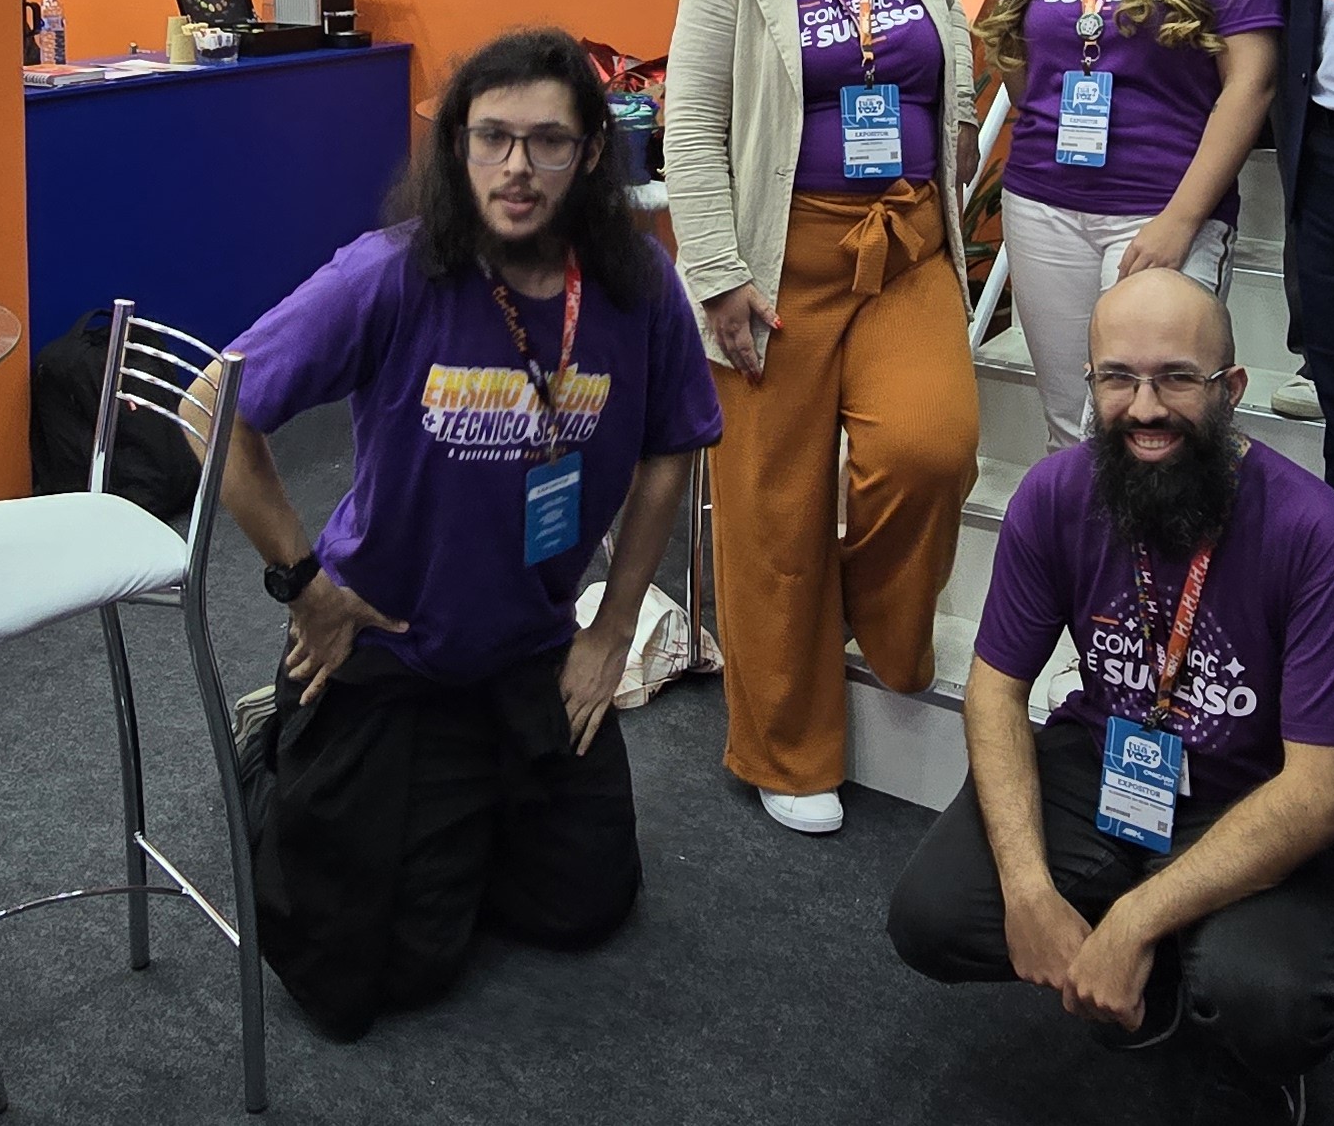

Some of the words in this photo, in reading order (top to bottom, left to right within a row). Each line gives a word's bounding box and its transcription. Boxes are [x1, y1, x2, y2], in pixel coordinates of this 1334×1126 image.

[804, 6, 842, 25] COM
[801, 27, 813, 47] É
[421, 364, 528, 411] ENSINO
[437, 409, 530, 444] TÉCNICO
[1092, 630, 1143, 659] COM
[1086, 648, 1098, 673] É
[1128, 741, 1147, 754] tua
[1117, 778, 1161, 798] EXPOSITOR
